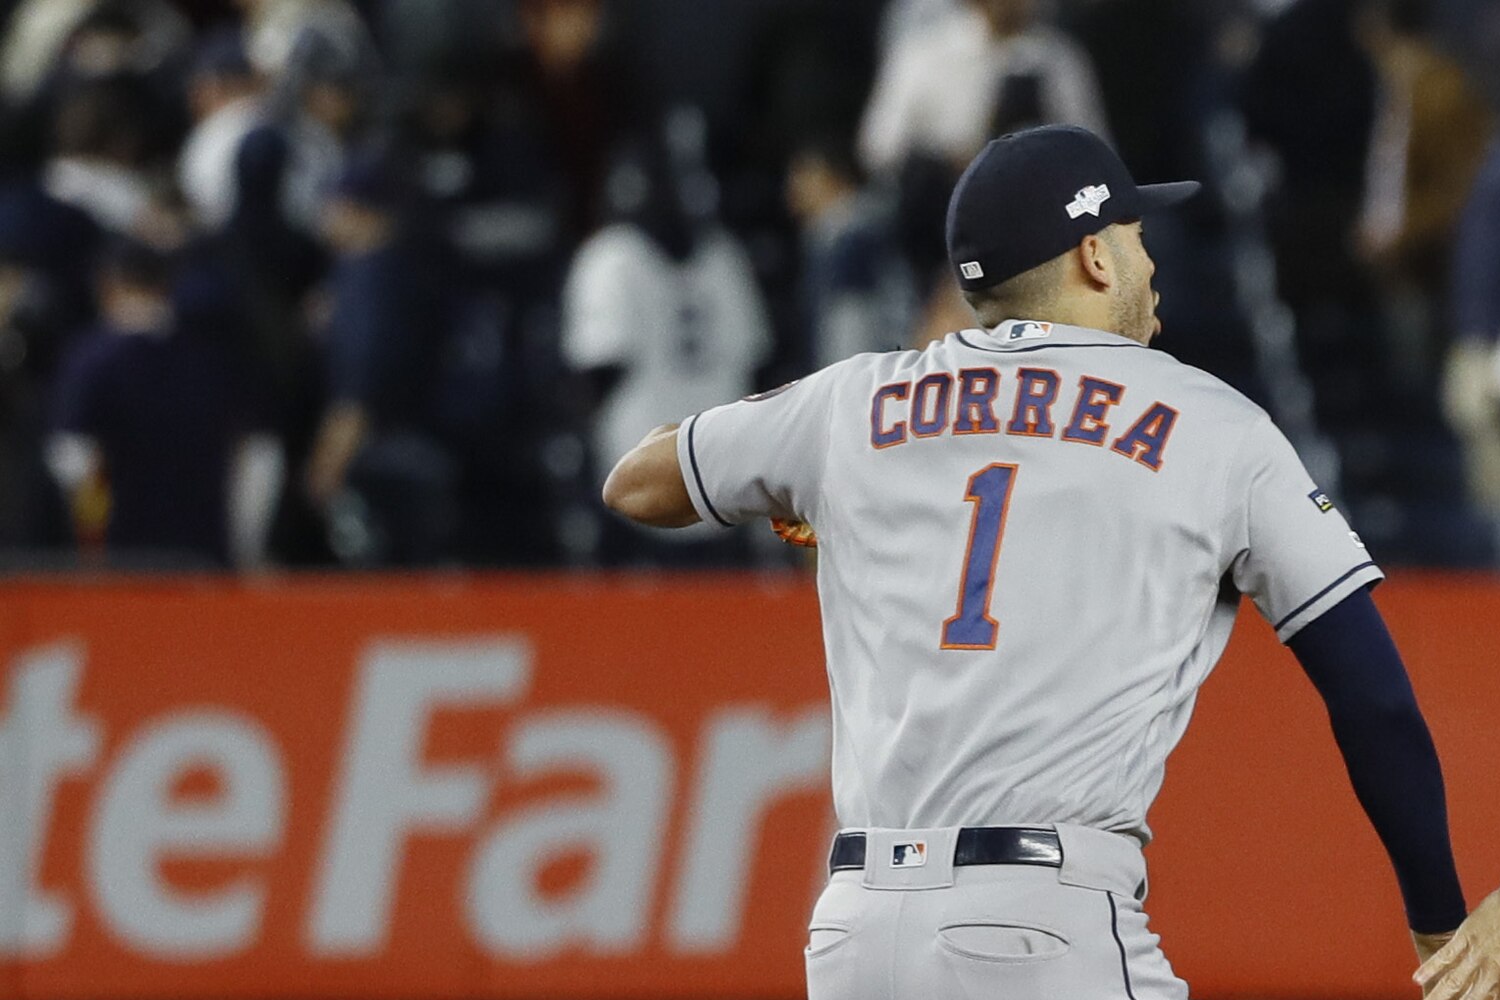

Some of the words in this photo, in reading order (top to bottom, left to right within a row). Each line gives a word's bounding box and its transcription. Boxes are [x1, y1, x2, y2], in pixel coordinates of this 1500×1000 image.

[871, 367, 1180, 472] CORREA
[940, 462, 1019, 650] 1
[0, 636, 286, 958] te
